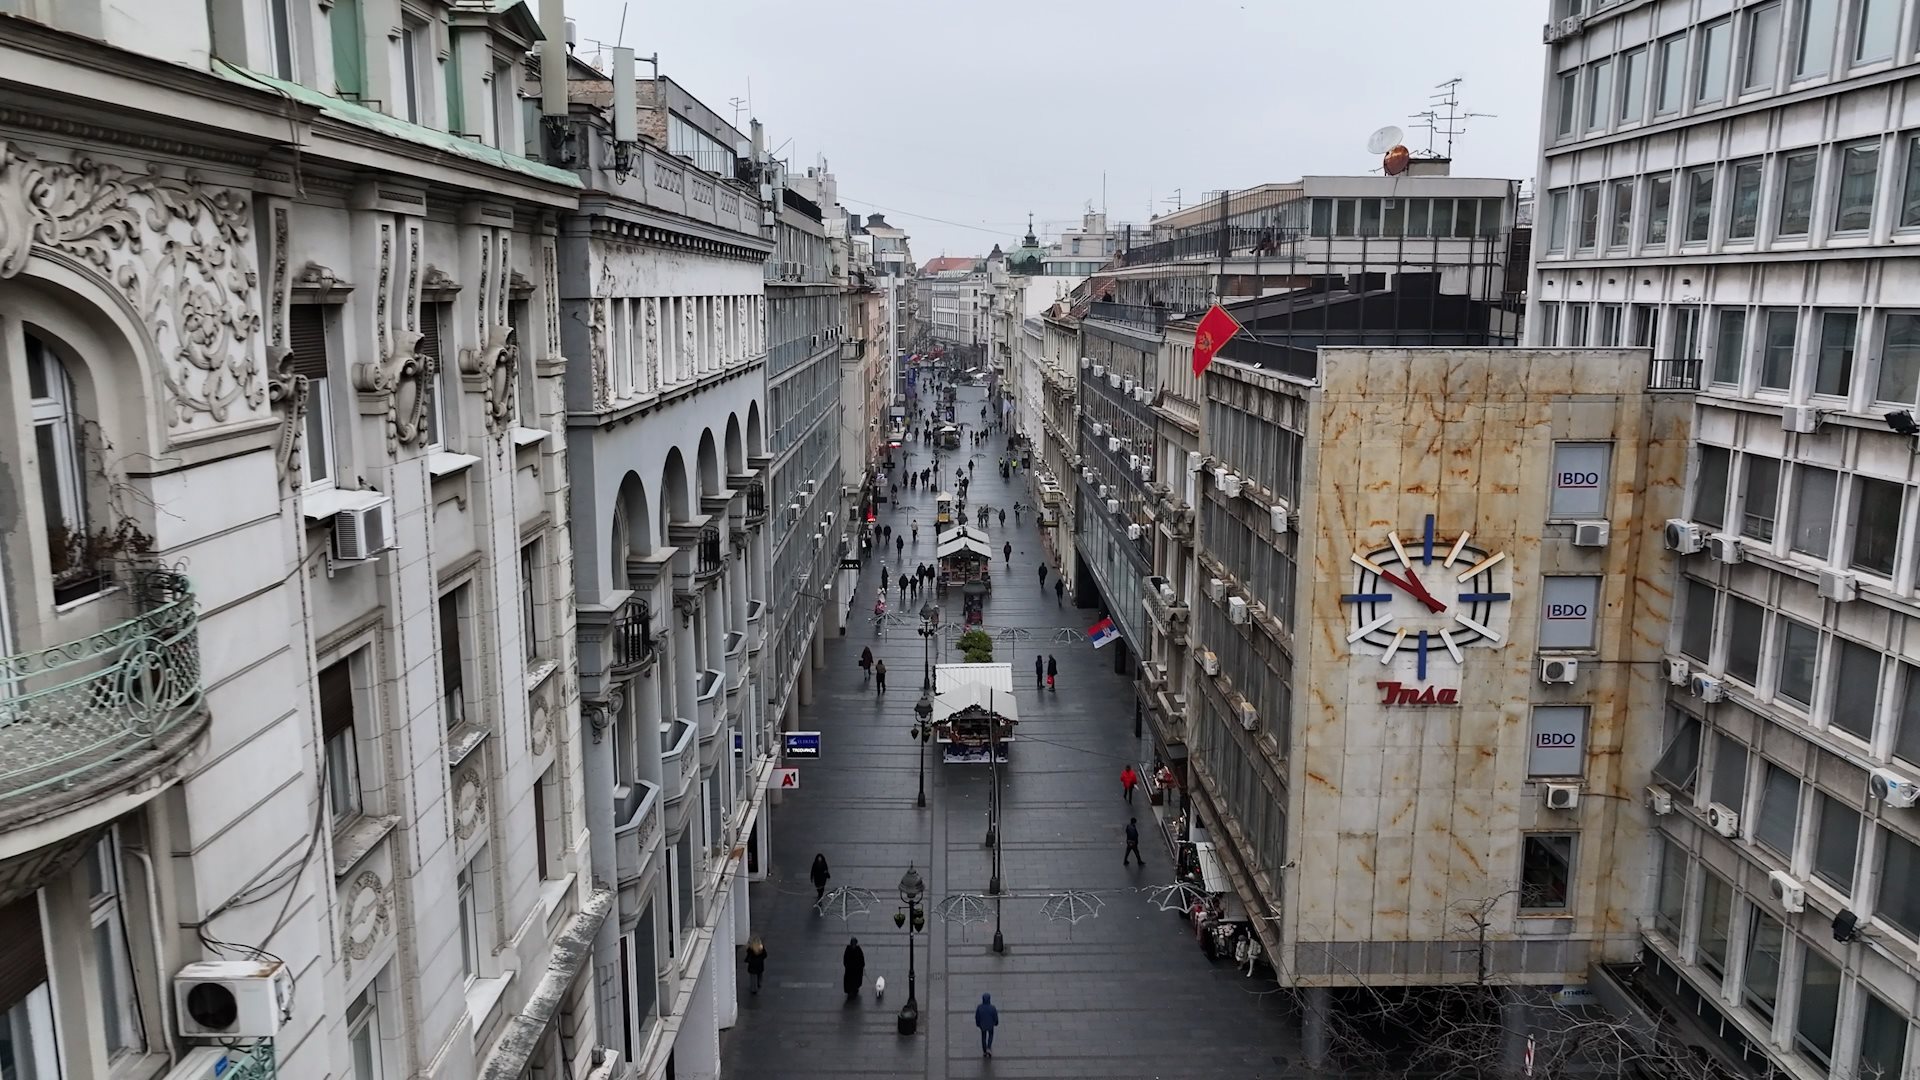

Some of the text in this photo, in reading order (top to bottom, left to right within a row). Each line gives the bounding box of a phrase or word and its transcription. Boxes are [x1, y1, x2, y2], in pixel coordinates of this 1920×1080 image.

[1562, 472, 1599, 485] BDO
[1552, 604, 1587, 617] BDO
[1541, 733, 1576, 745] BDO
[781, 772, 796, 787] A1
